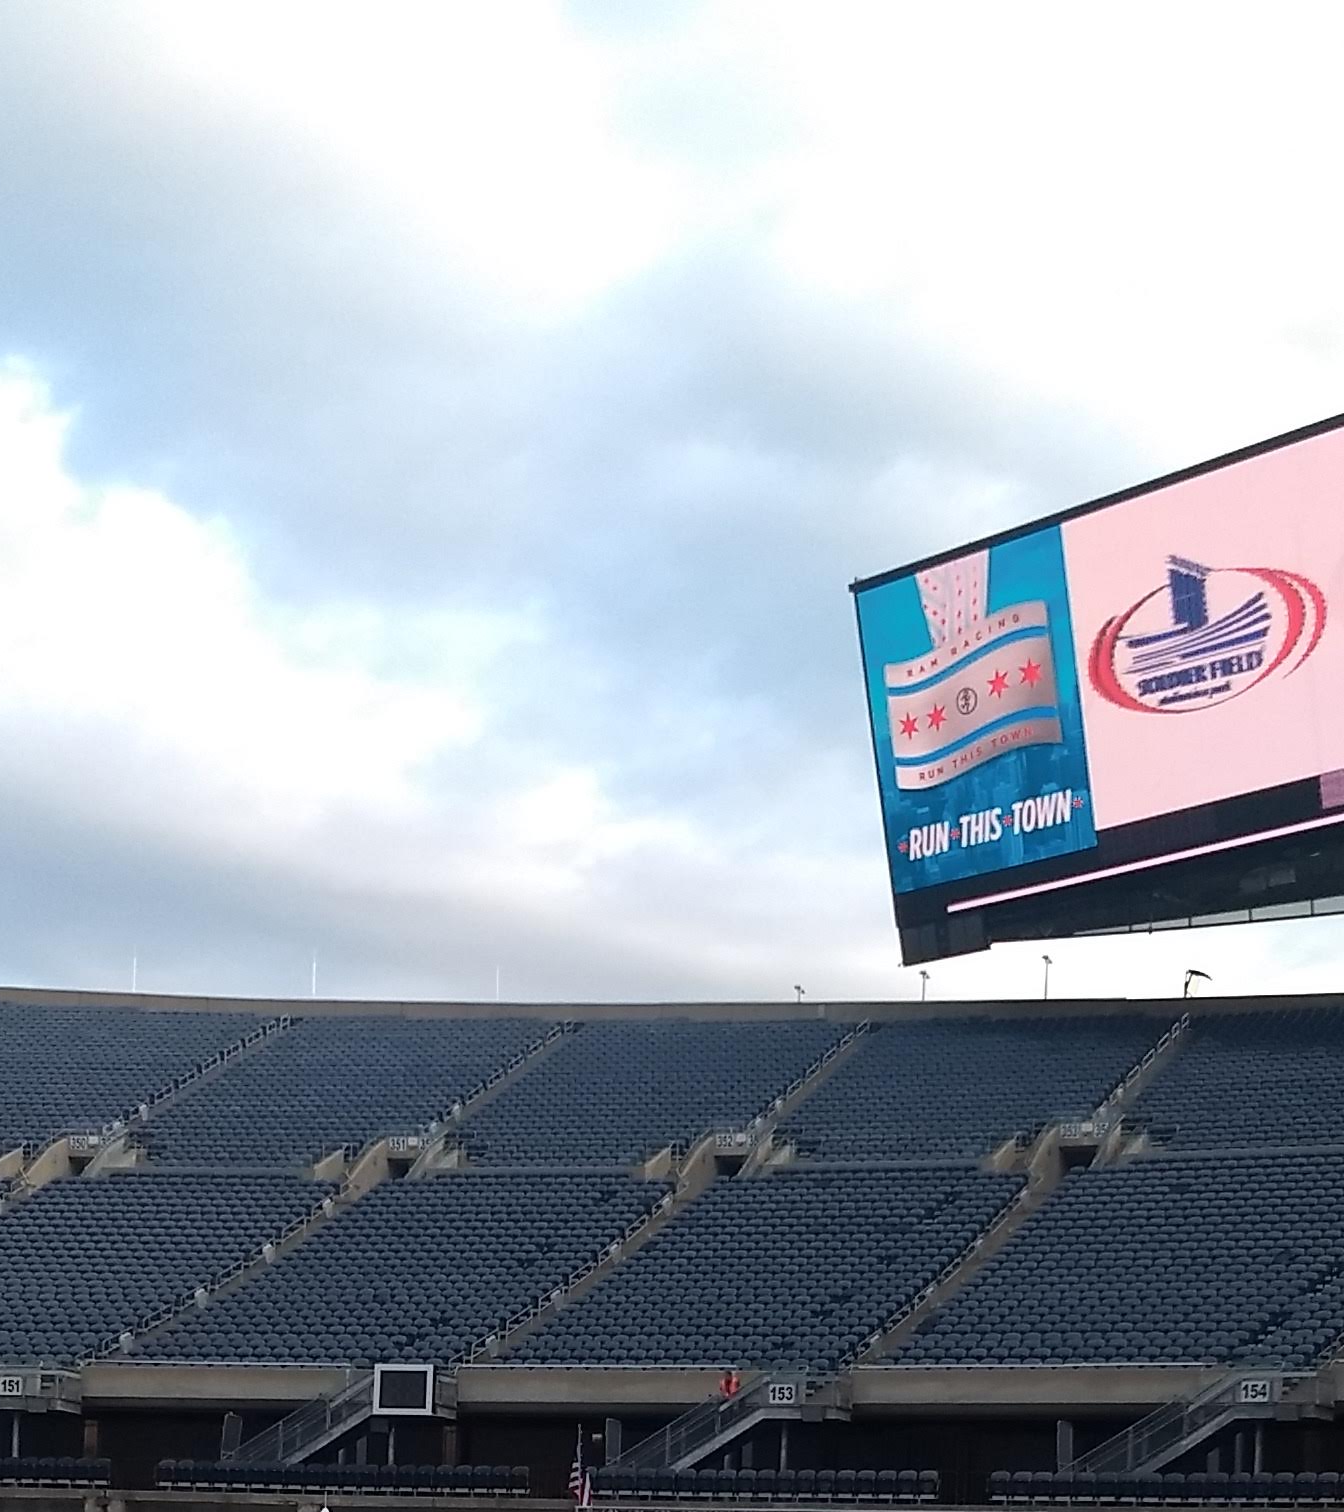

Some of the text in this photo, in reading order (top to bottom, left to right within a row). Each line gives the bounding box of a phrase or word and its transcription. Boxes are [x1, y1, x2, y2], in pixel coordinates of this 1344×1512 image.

[907, 614, 1020, 677] RAM RACING
[918, 726, 1034, 781] RUN THIS TOWN
[909, 789, 1072, 861] RUN THIS TOWN
[2, 1379, 20, 1393] 151
[770, 1386, 793, 1401] 153
[1242, 1383, 1267, 1399] 154
